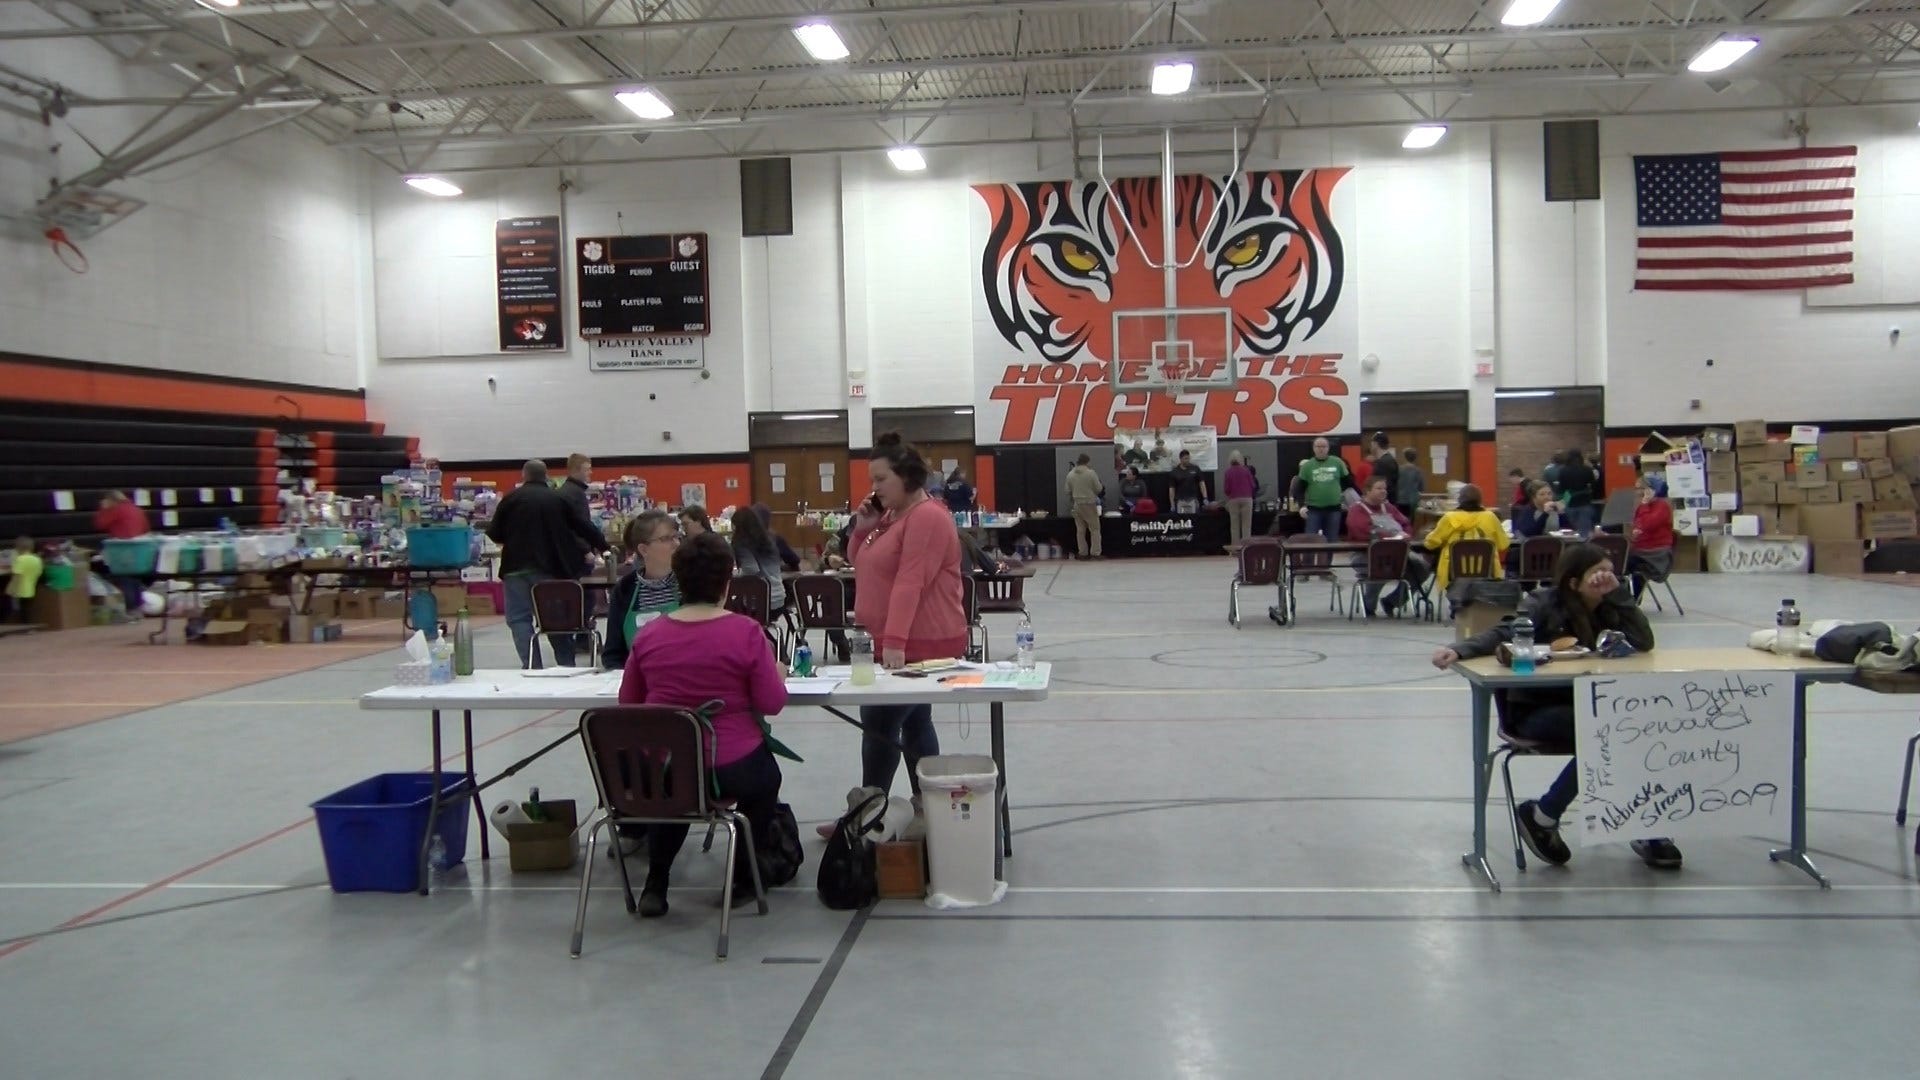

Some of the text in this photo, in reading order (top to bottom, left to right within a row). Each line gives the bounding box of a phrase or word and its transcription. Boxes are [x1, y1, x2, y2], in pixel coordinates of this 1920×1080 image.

[583, 264, 616, 276] TIGERS
[670, 261, 700, 272] GUEST
[581, 299, 602, 308] FOULS
[621, 298, 645, 306] PLAYER
[683, 296, 704, 304] FOULS
[581, 327, 602, 335] SCORE
[631, 325, 655, 333] MATCH
[683, 323, 705, 331] SCORE
[598, 336, 696, 348] PLATTE VALLEY
[630, 349, 663, 358] BANK
[1001, 361, 1153, 385] HOME
[1239, 353, 1344, 376] THE
[990, 374, 1350, 442] TIGERS
[1130, 519, 1193, 534] Smithfield
[1591, 673, 1775, 718] From Butler
[1615, 704, 1752, 744] Seward
[1643, 739, 1741, 778] County
